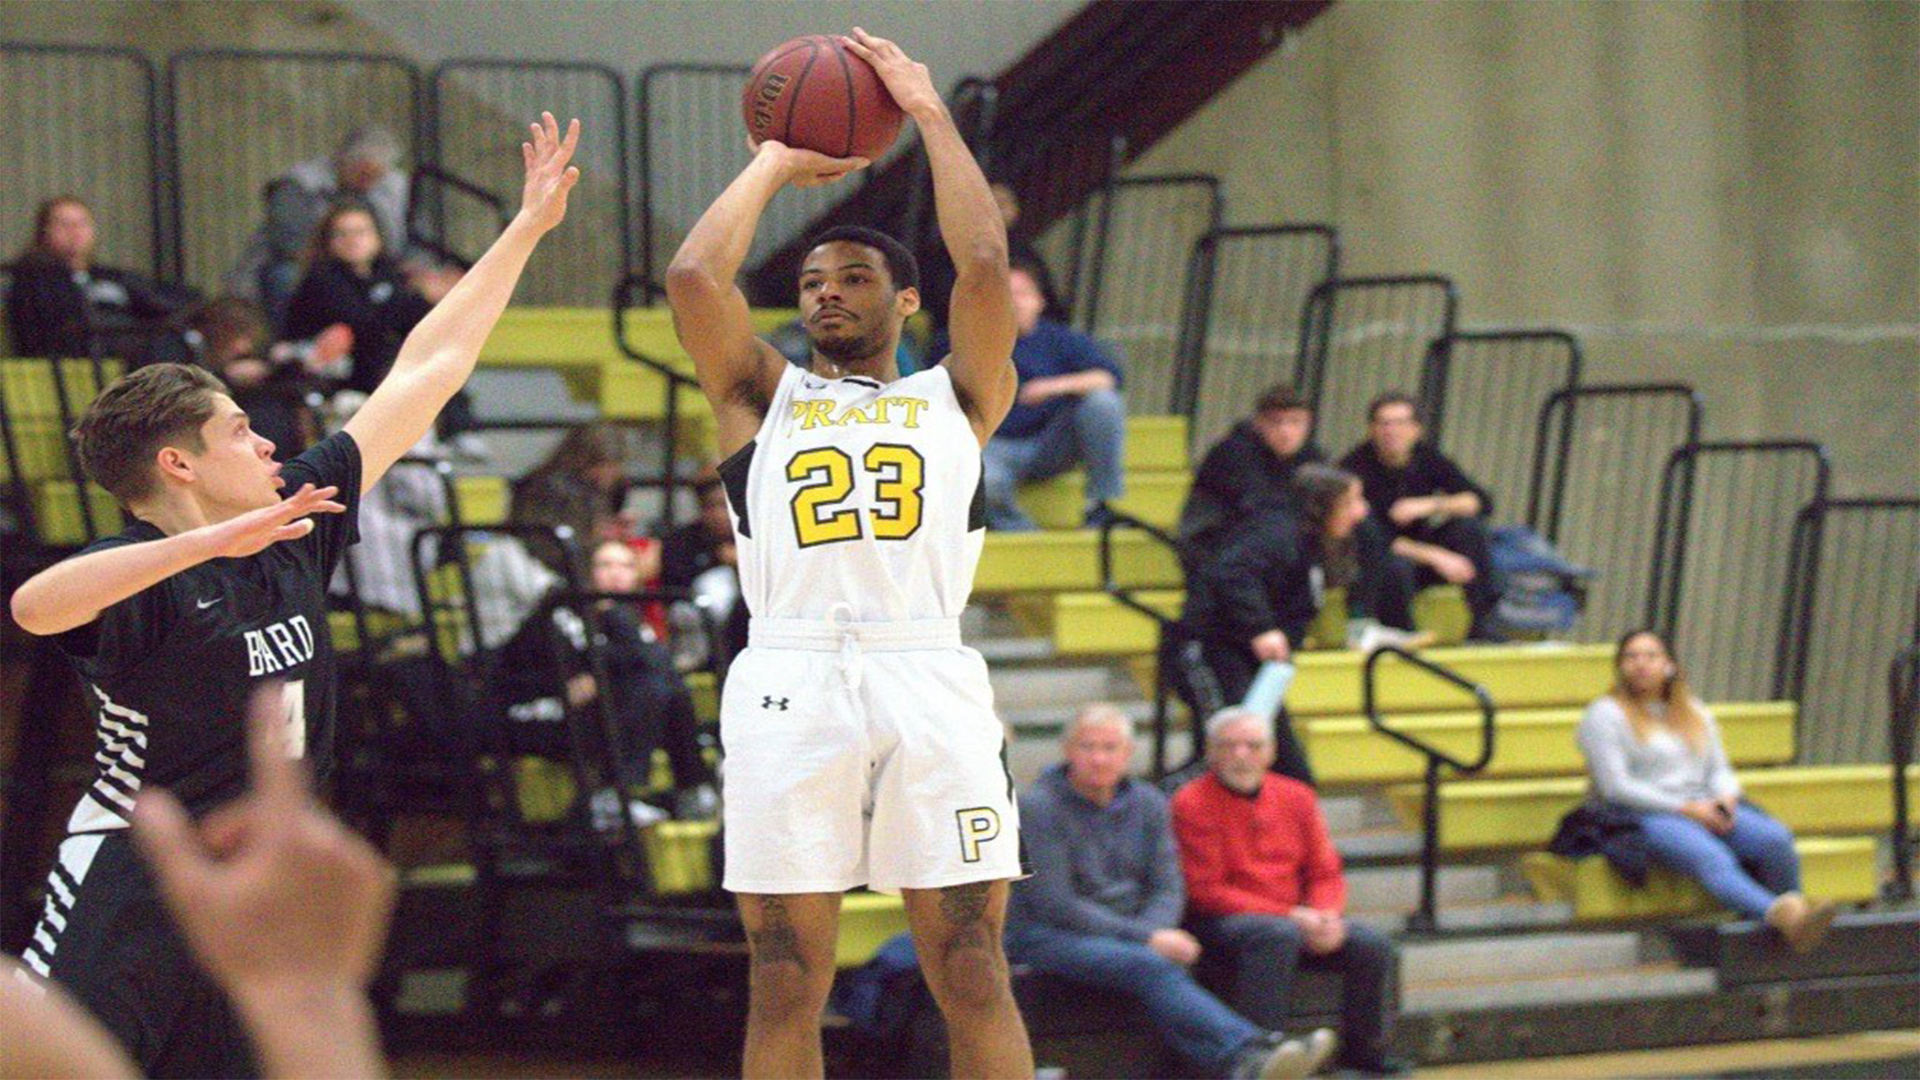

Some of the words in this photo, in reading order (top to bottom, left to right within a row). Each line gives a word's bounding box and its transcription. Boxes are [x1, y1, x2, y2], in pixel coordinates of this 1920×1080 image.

[785, 442, 925, 549] 23
[243, 615, 314, 676] BARD
[955, 806, 1000, 863] P
